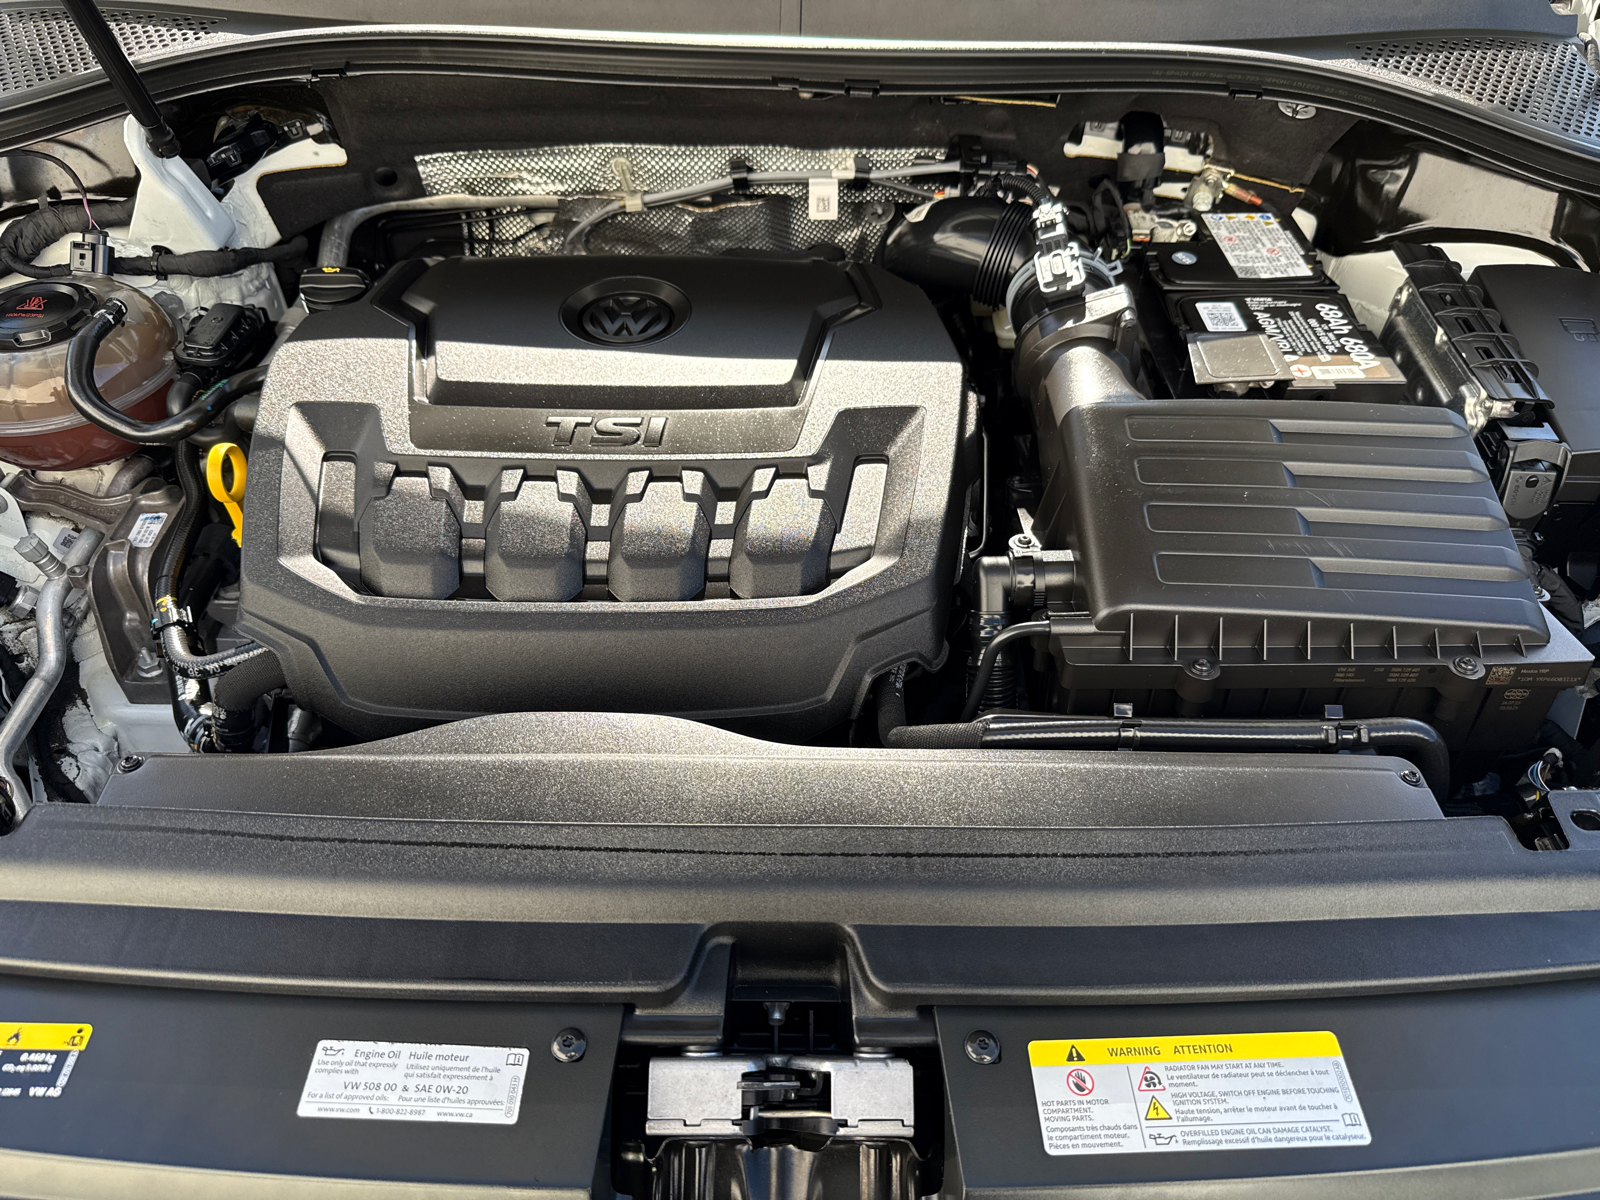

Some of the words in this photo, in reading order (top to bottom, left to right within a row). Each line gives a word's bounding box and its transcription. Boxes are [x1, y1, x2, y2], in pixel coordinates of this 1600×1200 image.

[1315, 303, 1352, 334] 68Ah
[1340, 337, 1380, 370] 680A
[546, 416, 668, 447] TSI
[354, 1049, 385, 1060] Engine
[387, 1050, 401, 1059] Oil
[409, 1051, 433, 1060] Huile
[1107, 1046, 1161, 1057] WARNING
[1174, 1044, 1233, 1055] ATTENTION
[343, 1081, 361, 1090] VW
[362, 1082, 381, 1091] 508
[384, 1082, 397, 1091] 00
[414, 1084, 434, 1093] SAE
[435, 1085, 469, 1094] 0W-20
[376, 1108, 425, 1116] 1-800-822-8987
[1055, 1134, 1102, 1142] compartiment
